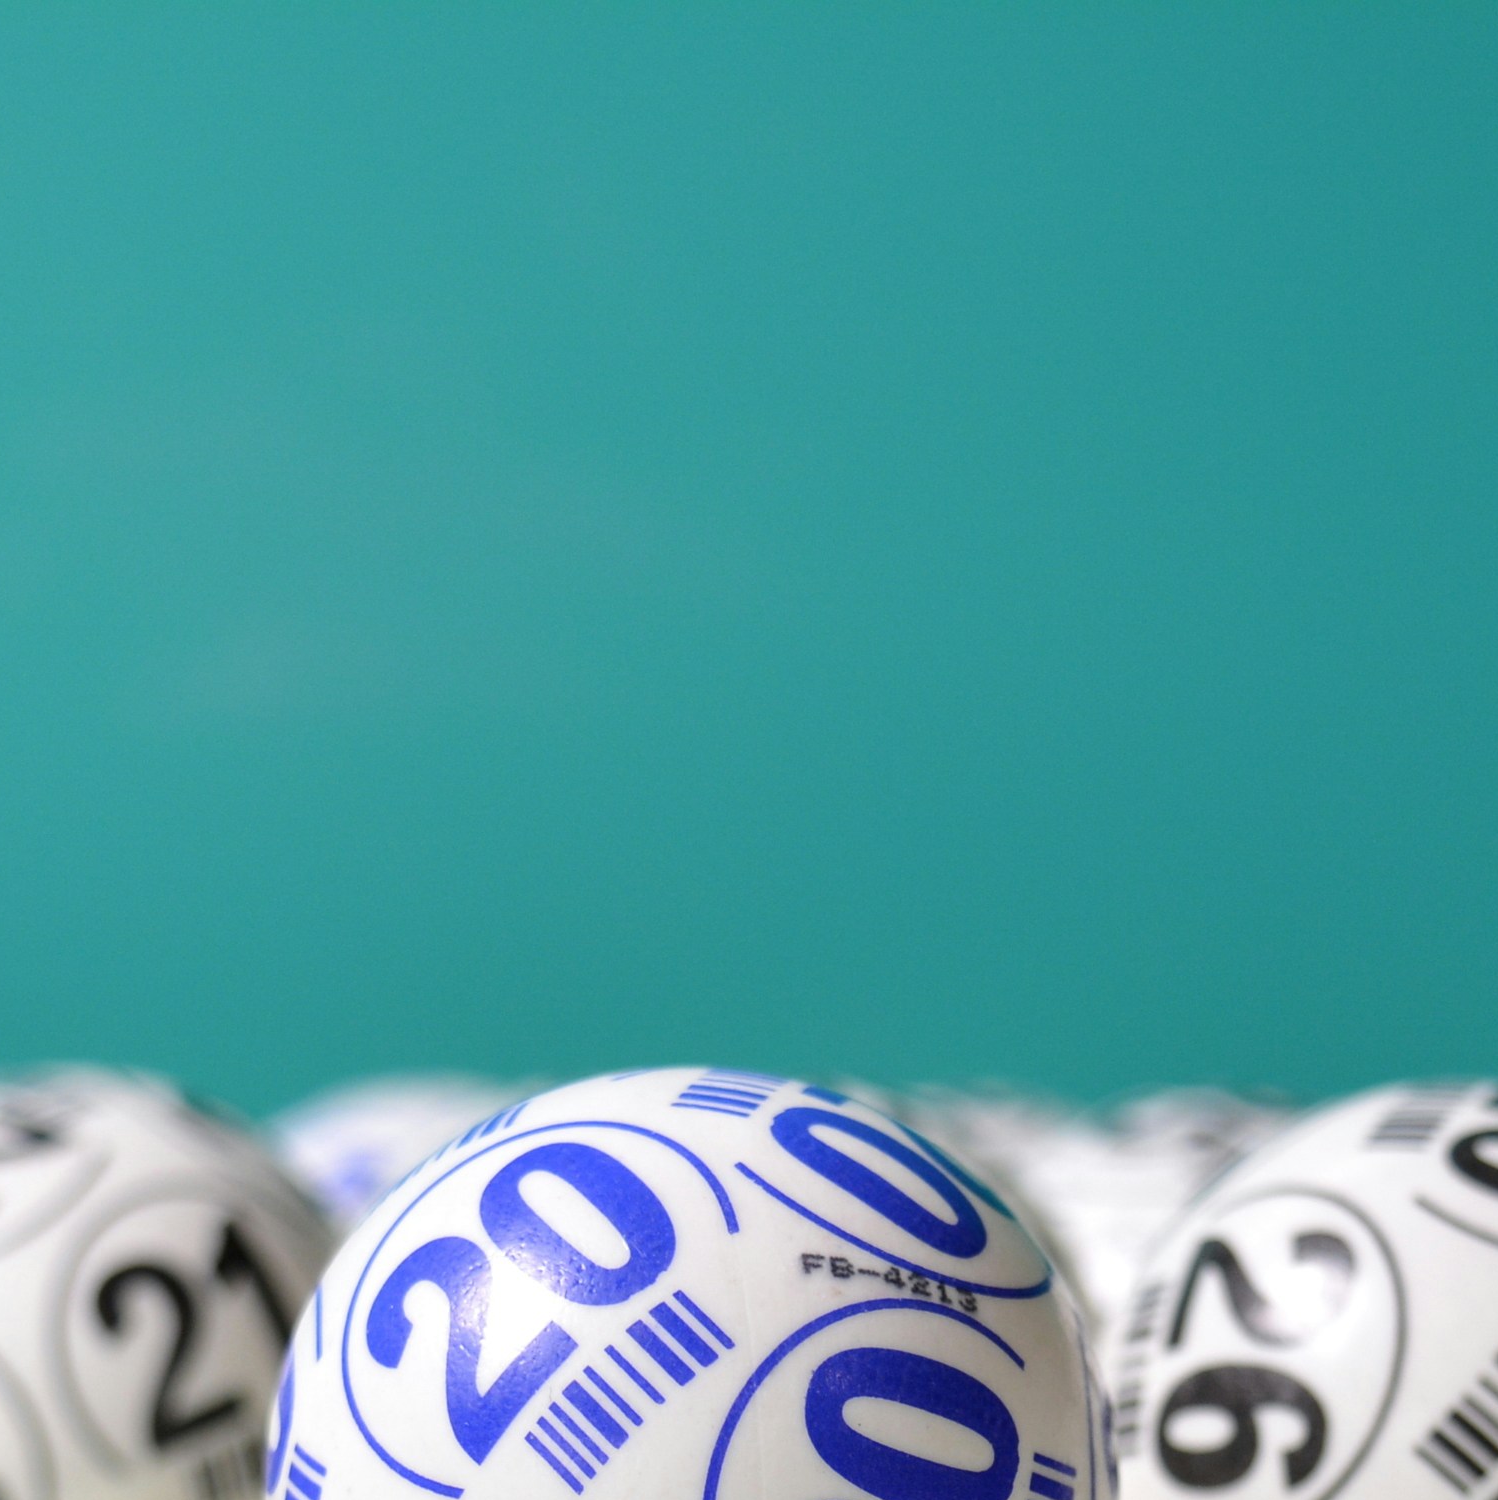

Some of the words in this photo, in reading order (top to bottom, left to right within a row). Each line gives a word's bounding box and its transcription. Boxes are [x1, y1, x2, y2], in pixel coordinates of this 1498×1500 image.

[769, 1083, 1018, 1260] 0
[801, 1253, 978, 1314] FB-4213
[99, 1218, 294, 1456] 21
[367, 1142, 676, 1466] 20
[1156, 1229, 1358, 1497] 26
